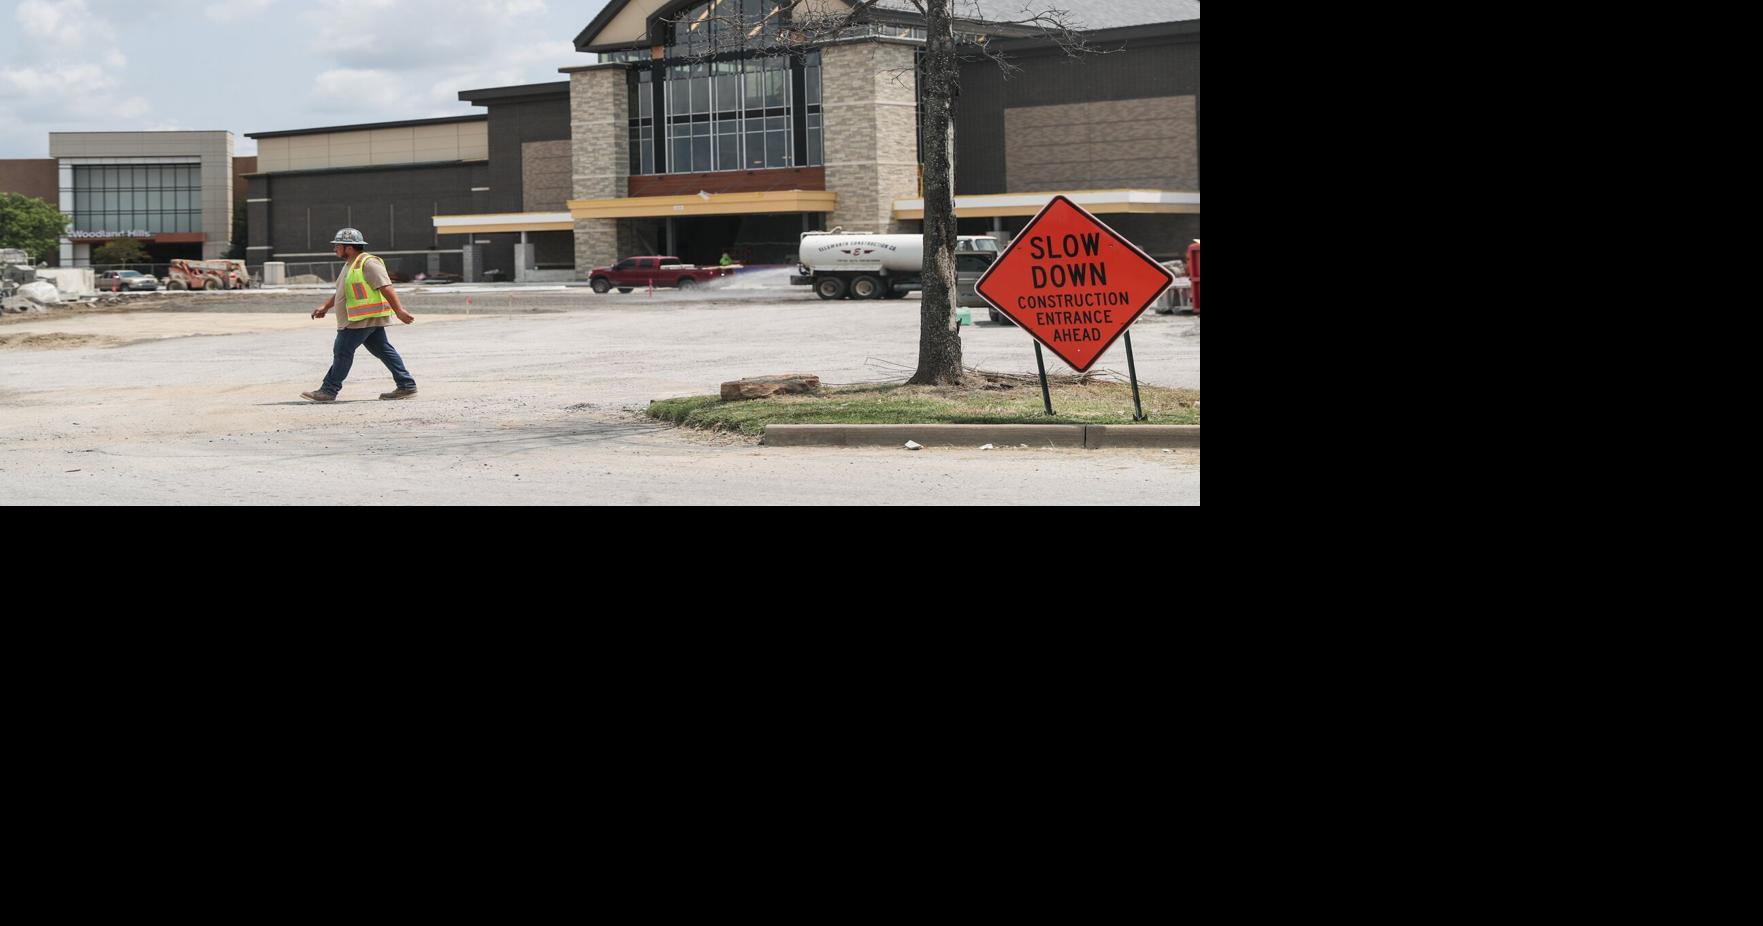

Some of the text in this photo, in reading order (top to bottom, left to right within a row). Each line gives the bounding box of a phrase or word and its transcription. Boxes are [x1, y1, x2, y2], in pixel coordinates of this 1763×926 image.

[127, 230, 151, 238] Hills
[1030, 232, 1100, 259] SLOW
[1031, 262, 1107, 288] DOWN
[1017, 292, 1129, 309] CONSTRUCTION
[1036, 310, 1113, 325] ENTRANCE
[1053, 328, 1101, 342] AHEAD
